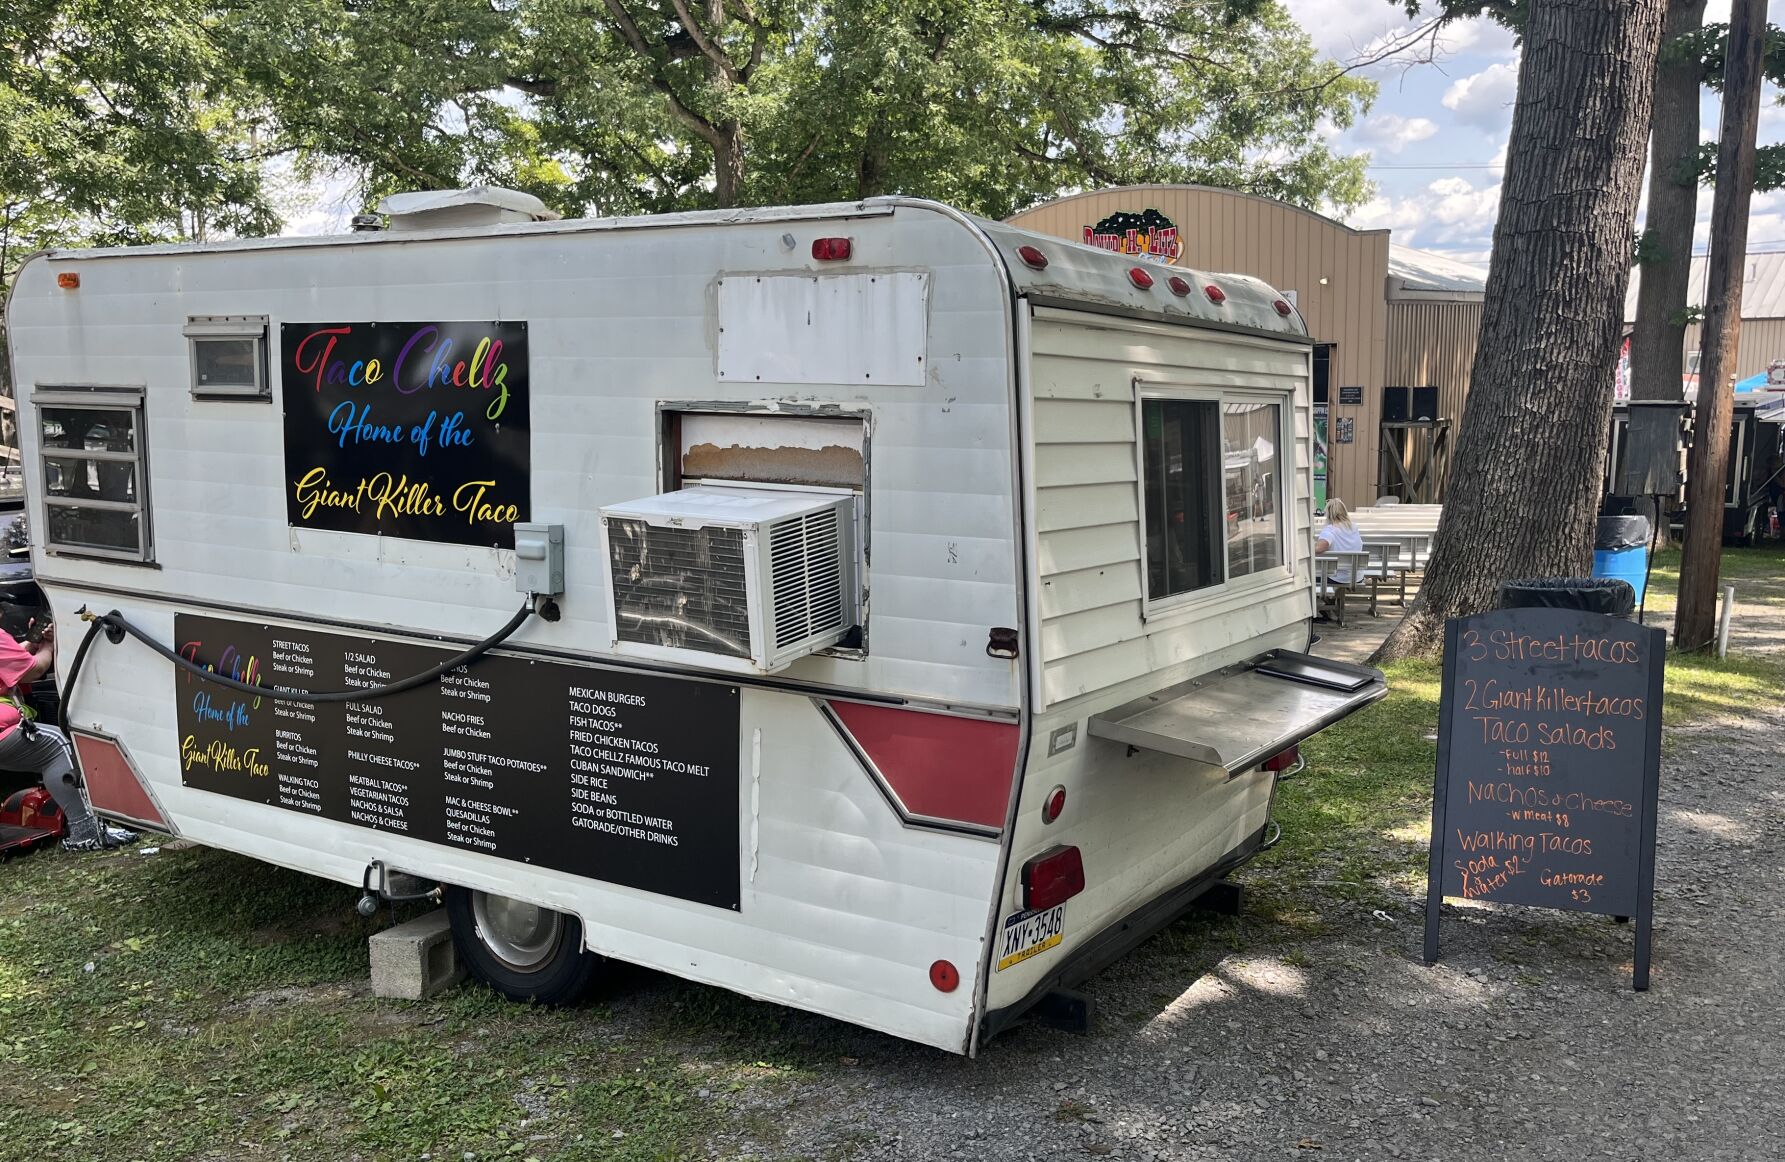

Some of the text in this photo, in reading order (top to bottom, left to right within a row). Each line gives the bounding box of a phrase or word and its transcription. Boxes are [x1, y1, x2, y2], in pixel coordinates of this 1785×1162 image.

[296, 325, 511, 420] Taco Chellz
[328, 401, 474, 456] Home of the
[294, 467, 520, 525] Giant Killer Taco
[273, 640, 309, 652] STREET TACOS
[1464, 630, 1487, 661] 3
[273, 651, 284, 660] Beef
[292, 654, 312, 664] Chicken
[345, 652, 375, 664] 1/2 SALAD
[273, 663, 287, 672] Steak
[295, 666, 314, 677] Shrimp
[345, 664, 358, 674] Beef
[366, 668, 390, 679] Chicken
[345, 677, 361, 687] Steak
[441, 675, 455, 683] Beef
[464, 678, 489, 689] Chicken
[441, 687, 458, 697] Steak
[467, 691, 491, 703] Shrimp
[569, 687, 645, 706] MEXICAN BURGERS
[1465, 679, 1480, 710] 2
[194, 691, 249, 731] Home of the
[275, 708, 289, 717] Steak
[296, 711, 315, 723] Shrimp
[346, 702, 382, 715] FULL SALAD
[569, 701, 616, 717] TACO DOGS
[347, 714, 359, 723] Beef
[368, 718, 392, 729] Chicken
[442, 711, 484, 725] NACHO FRIES
[570, 716, 587, 727] FISH
[276, 730, 301, 741] BURRITOS
[347, 726, 363, 736] Steak
[372, 731, 394, 743] Shrimp
[443, 723, 456, 733] Beef
[465, 727, 491, 739] Chicken
[1473, 716, 1615, 750] Taco Salads
[570, 730, 658, 753] FRIED CHICKEN TACOS
[182, 735, 269, 777] Giant Killer Taco
[348, 750, 368, 761] PHILLY
[369, 755, 392, 766] CHEESE
[443, 748, 466, 759] JUMBO
[467, 752, 487, 762] STUFF
[488, 755, 505, 766] TACO
[570, 745, 710, 776] TACO CHELLZ FAMOUS TACO MELT
[1532, 751, 1549, 763] $12
[444, 760, 458, 769] Beef
[467, 764, 492, 775] Chicken
[571, 760, 599, 772] CUBAN
[1534, 764, 1550, 776] $10
[278, 774, 318, 788] WALKING TACO
[350, 775, 381, 788] MEATBALL
[444, 772, 461, 782] Steak
[471, 777, 493, 789] Shrimp
[571, 774, 608, 789] SIDE RICE
[350, 787, 409, 806] VEGETARIAN TACOS
[446, 796, 460, 806] MAC
[462, 799, 466, 807] &
[467, 800, 491, 812] CHEESE
[571, 788, 617, 805] SIDE BEANS
[1565, 792, 1632, 817] Cheese
[351, 799, 403, 817] NACHOS & SALSA
[446, 808, 490, 824] QUESADILLAS
[572, 802, 672, 830] SODA or BOTTLED WATER
[352, 811, 408, 830] NACHOS & CHEESE
[447, 820, 460, 830] Beef
[470, 825, 495, 837] Chicken
[1556, 814, 1569, 827] $8
[572, 817, 678, 846] GATORADE/OTHER DRINKS
[447, 832, 464, 843] Steak
[474, 837, 496, 850] Shrimp
[1457, 829, 1592, 863] Walking Tacos
[1454, 856, 1525, 875] Soda $2
[1540, 868, 1605, 887] Gatorade
[1571, 889, 1591, 902] $3
[1018, 942, 1046, 958] TRAILER
